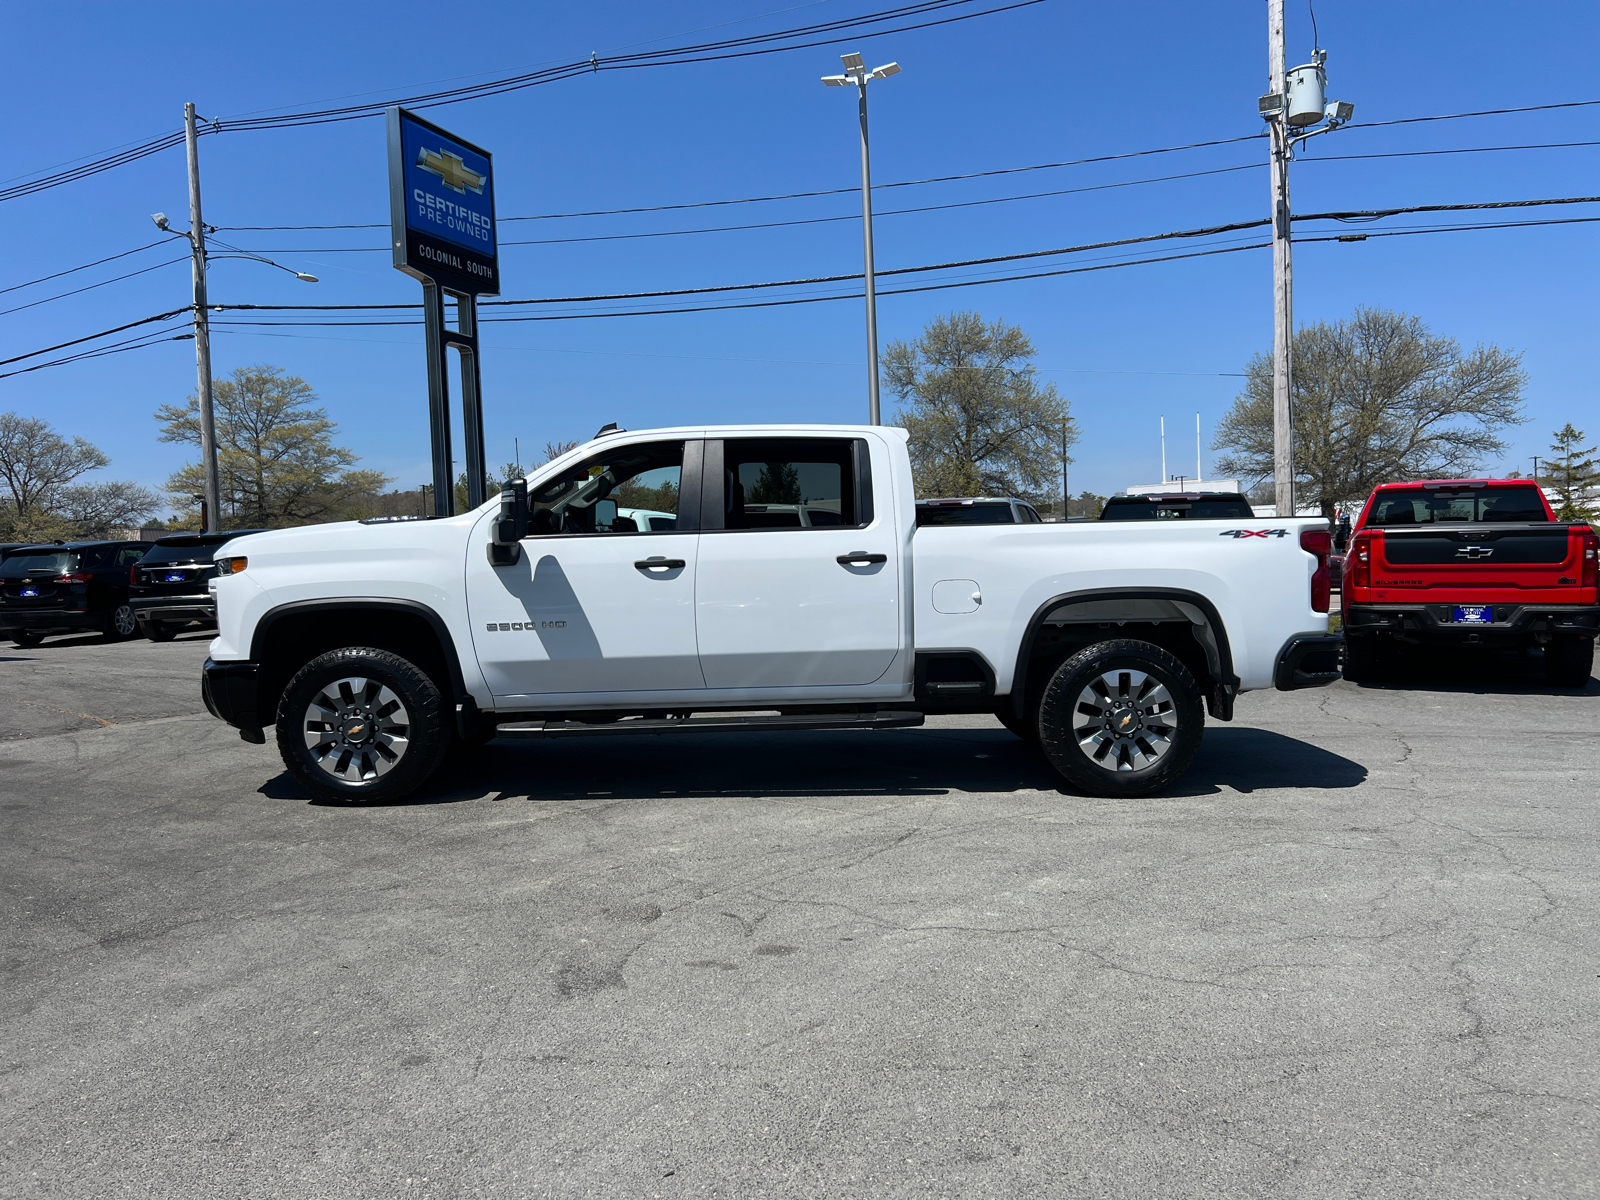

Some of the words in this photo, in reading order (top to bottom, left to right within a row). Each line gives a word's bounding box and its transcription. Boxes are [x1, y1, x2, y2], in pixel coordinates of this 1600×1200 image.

[413, 188, 491, 229] CERTIFIED
[419, 204, 489, 241] PRE-OWNED
[418, 244, 463, 269] COLONIAL
[466, 260, 493, 279] SOUTH
